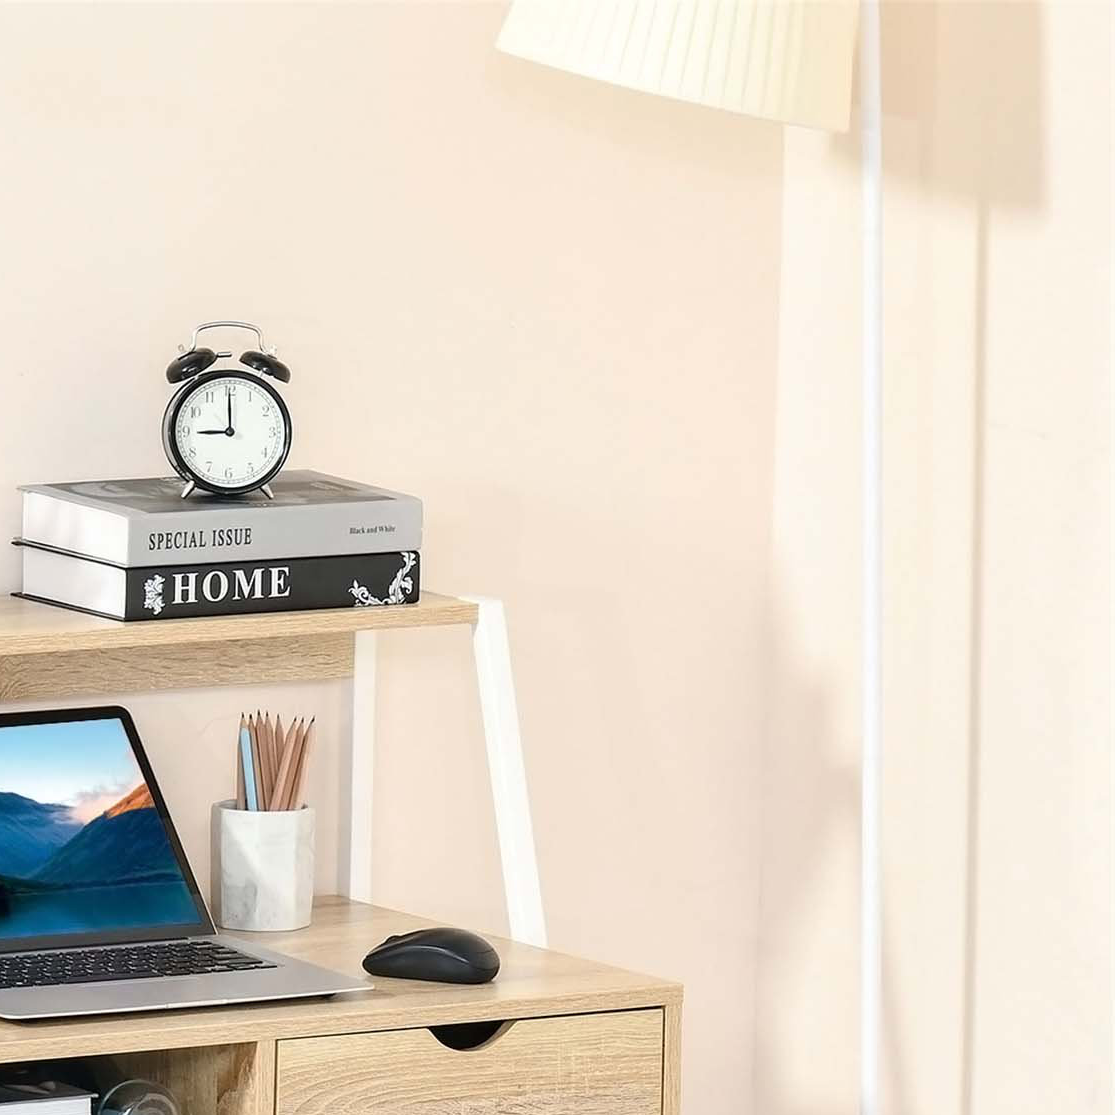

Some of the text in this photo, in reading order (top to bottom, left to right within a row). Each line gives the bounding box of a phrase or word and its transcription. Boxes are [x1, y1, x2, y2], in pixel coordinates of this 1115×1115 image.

[205, 391, 214, 403] 11
[190, 406, 201, 418] 10
[262, 406, 270, 417] 2
[182, 426, 190, 438] 9
[269, 427, 276, 438] 3
[189, 447, 196, 458] 8
[261, 447, 268, 458] 4
[205, 461, 212, 472] 7
[247, 462, 253, 474] 5
[224, 467, 233, 478] 6
[149, 528, 252, 550] SPECIAL ISSUE
[171, 567, 290, 604] HOME
